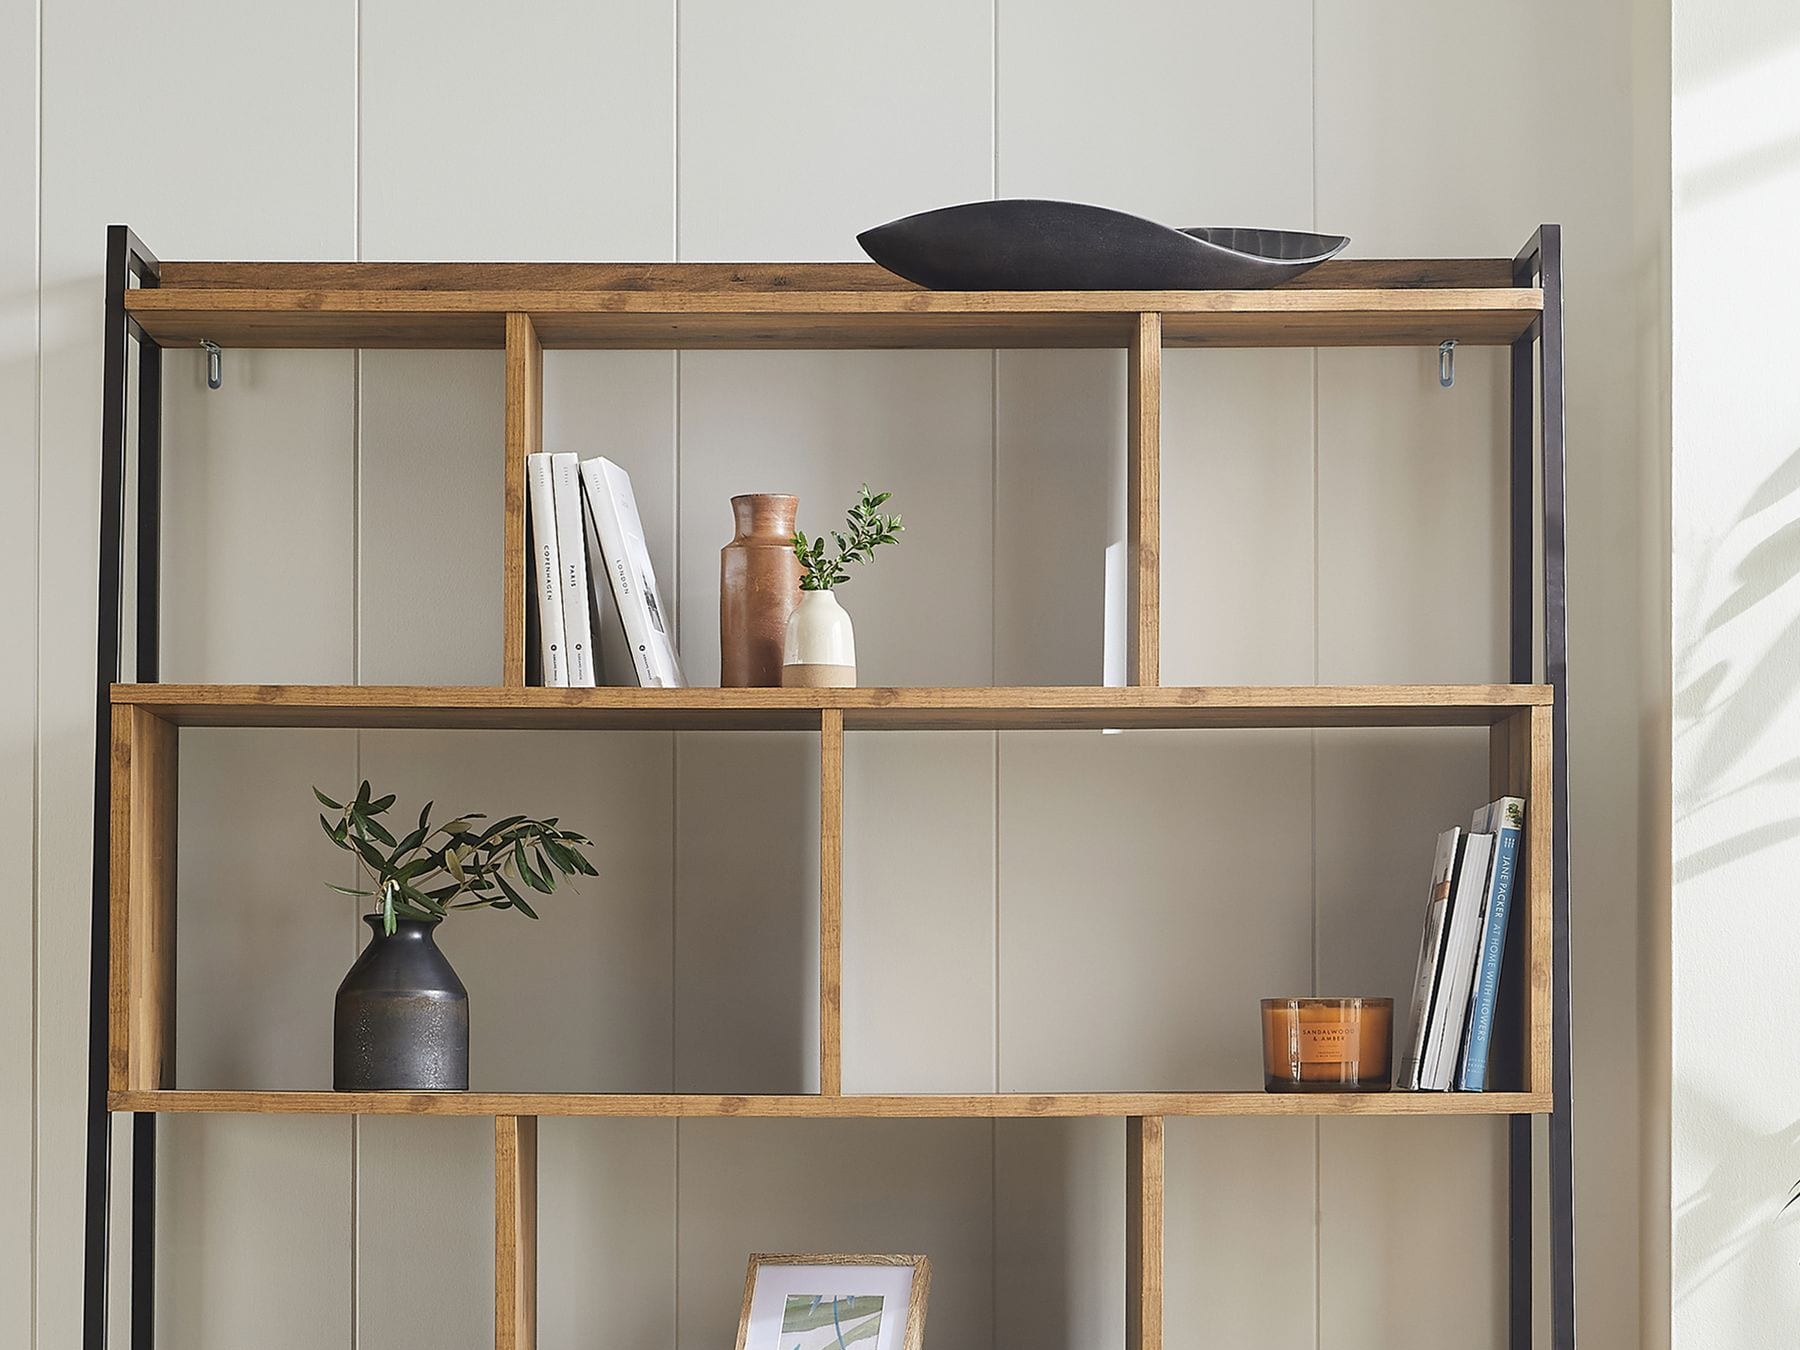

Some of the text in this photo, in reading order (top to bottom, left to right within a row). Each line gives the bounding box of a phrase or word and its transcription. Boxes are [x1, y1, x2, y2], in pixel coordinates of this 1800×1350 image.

[544, 544, 552, 600] COPENHAGEN
[616, 559, 630, 594] LONDON
[1476, 856, 1512, 1042] JANE PACKER AT HOME WITH FLOWERS
